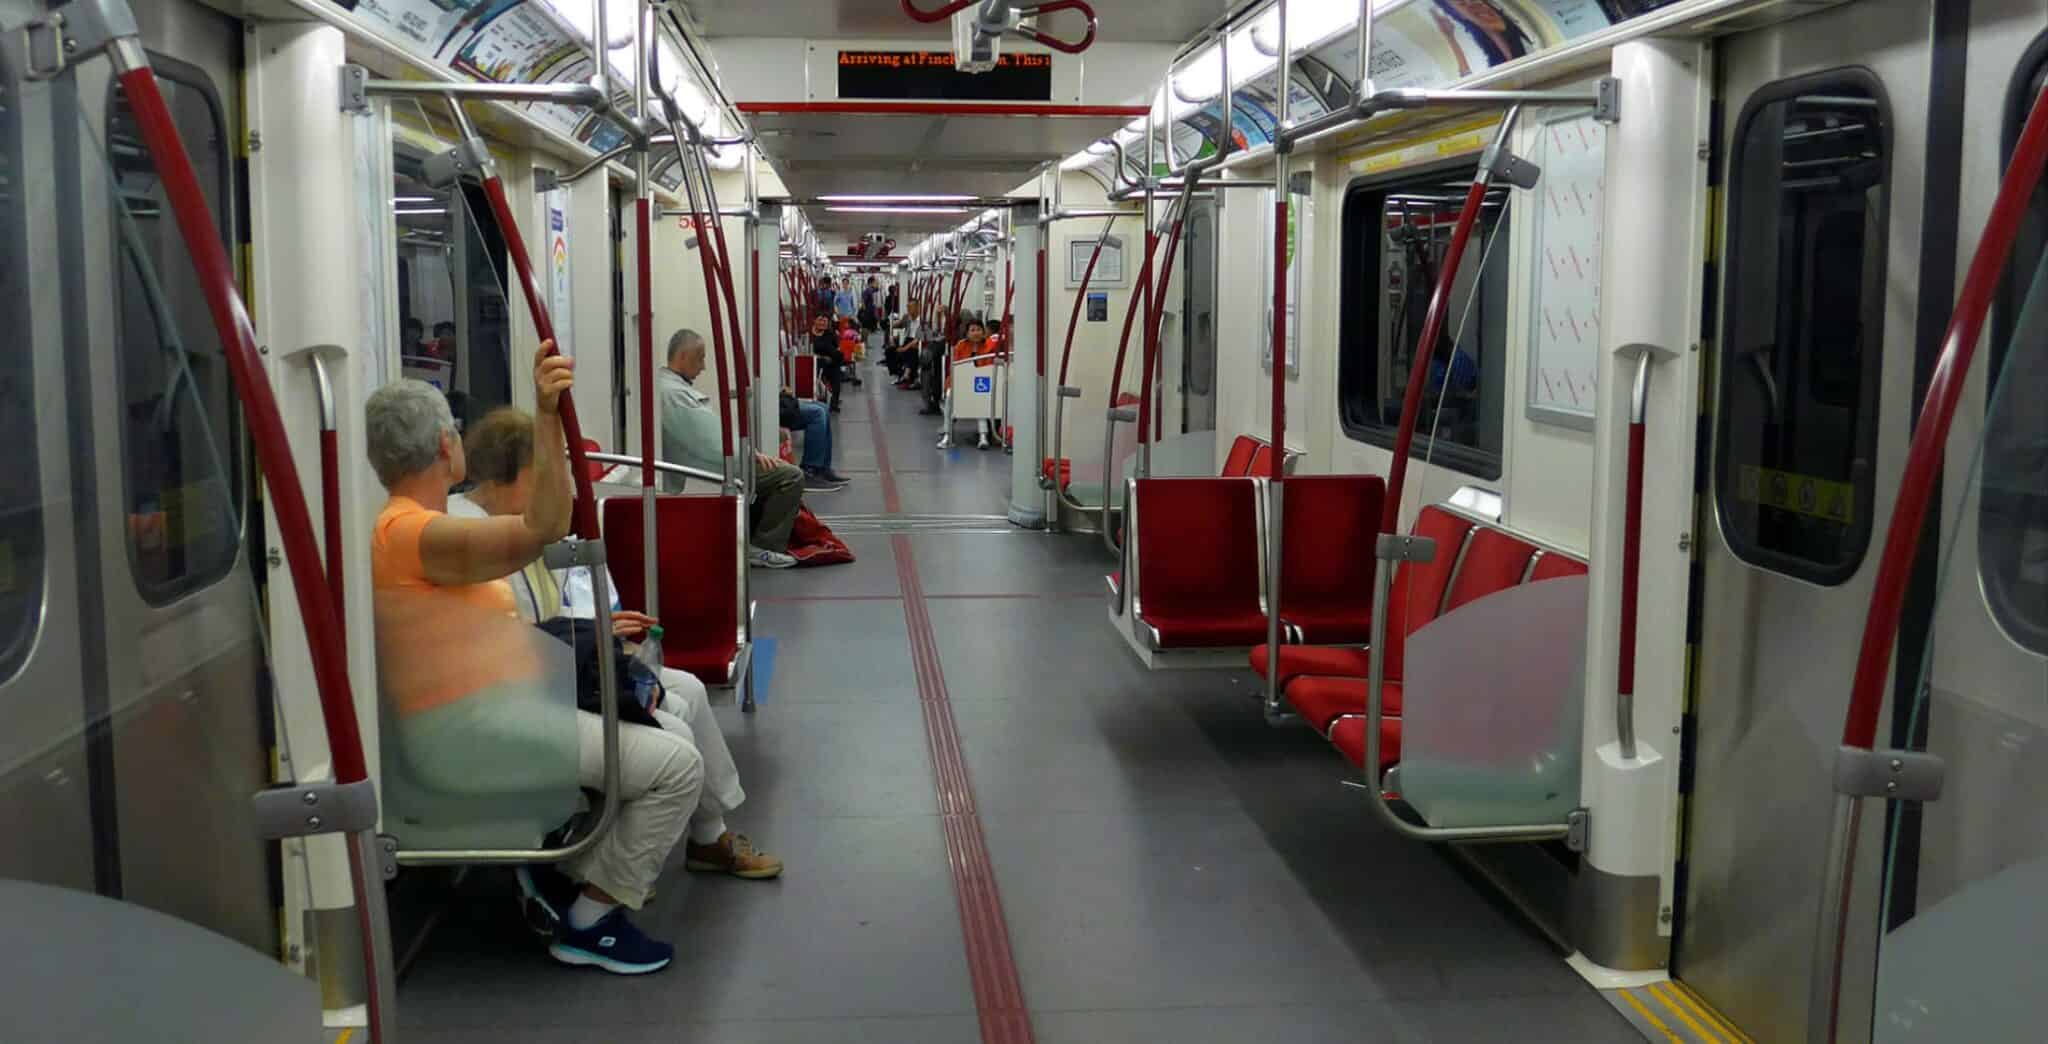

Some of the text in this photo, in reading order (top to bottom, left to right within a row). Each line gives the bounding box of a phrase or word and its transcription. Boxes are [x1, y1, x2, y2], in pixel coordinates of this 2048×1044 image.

[839, 52, 900, 67] Arriving
[903, 53, 916, 65] at
[1015, 53, 1042, 66] This
